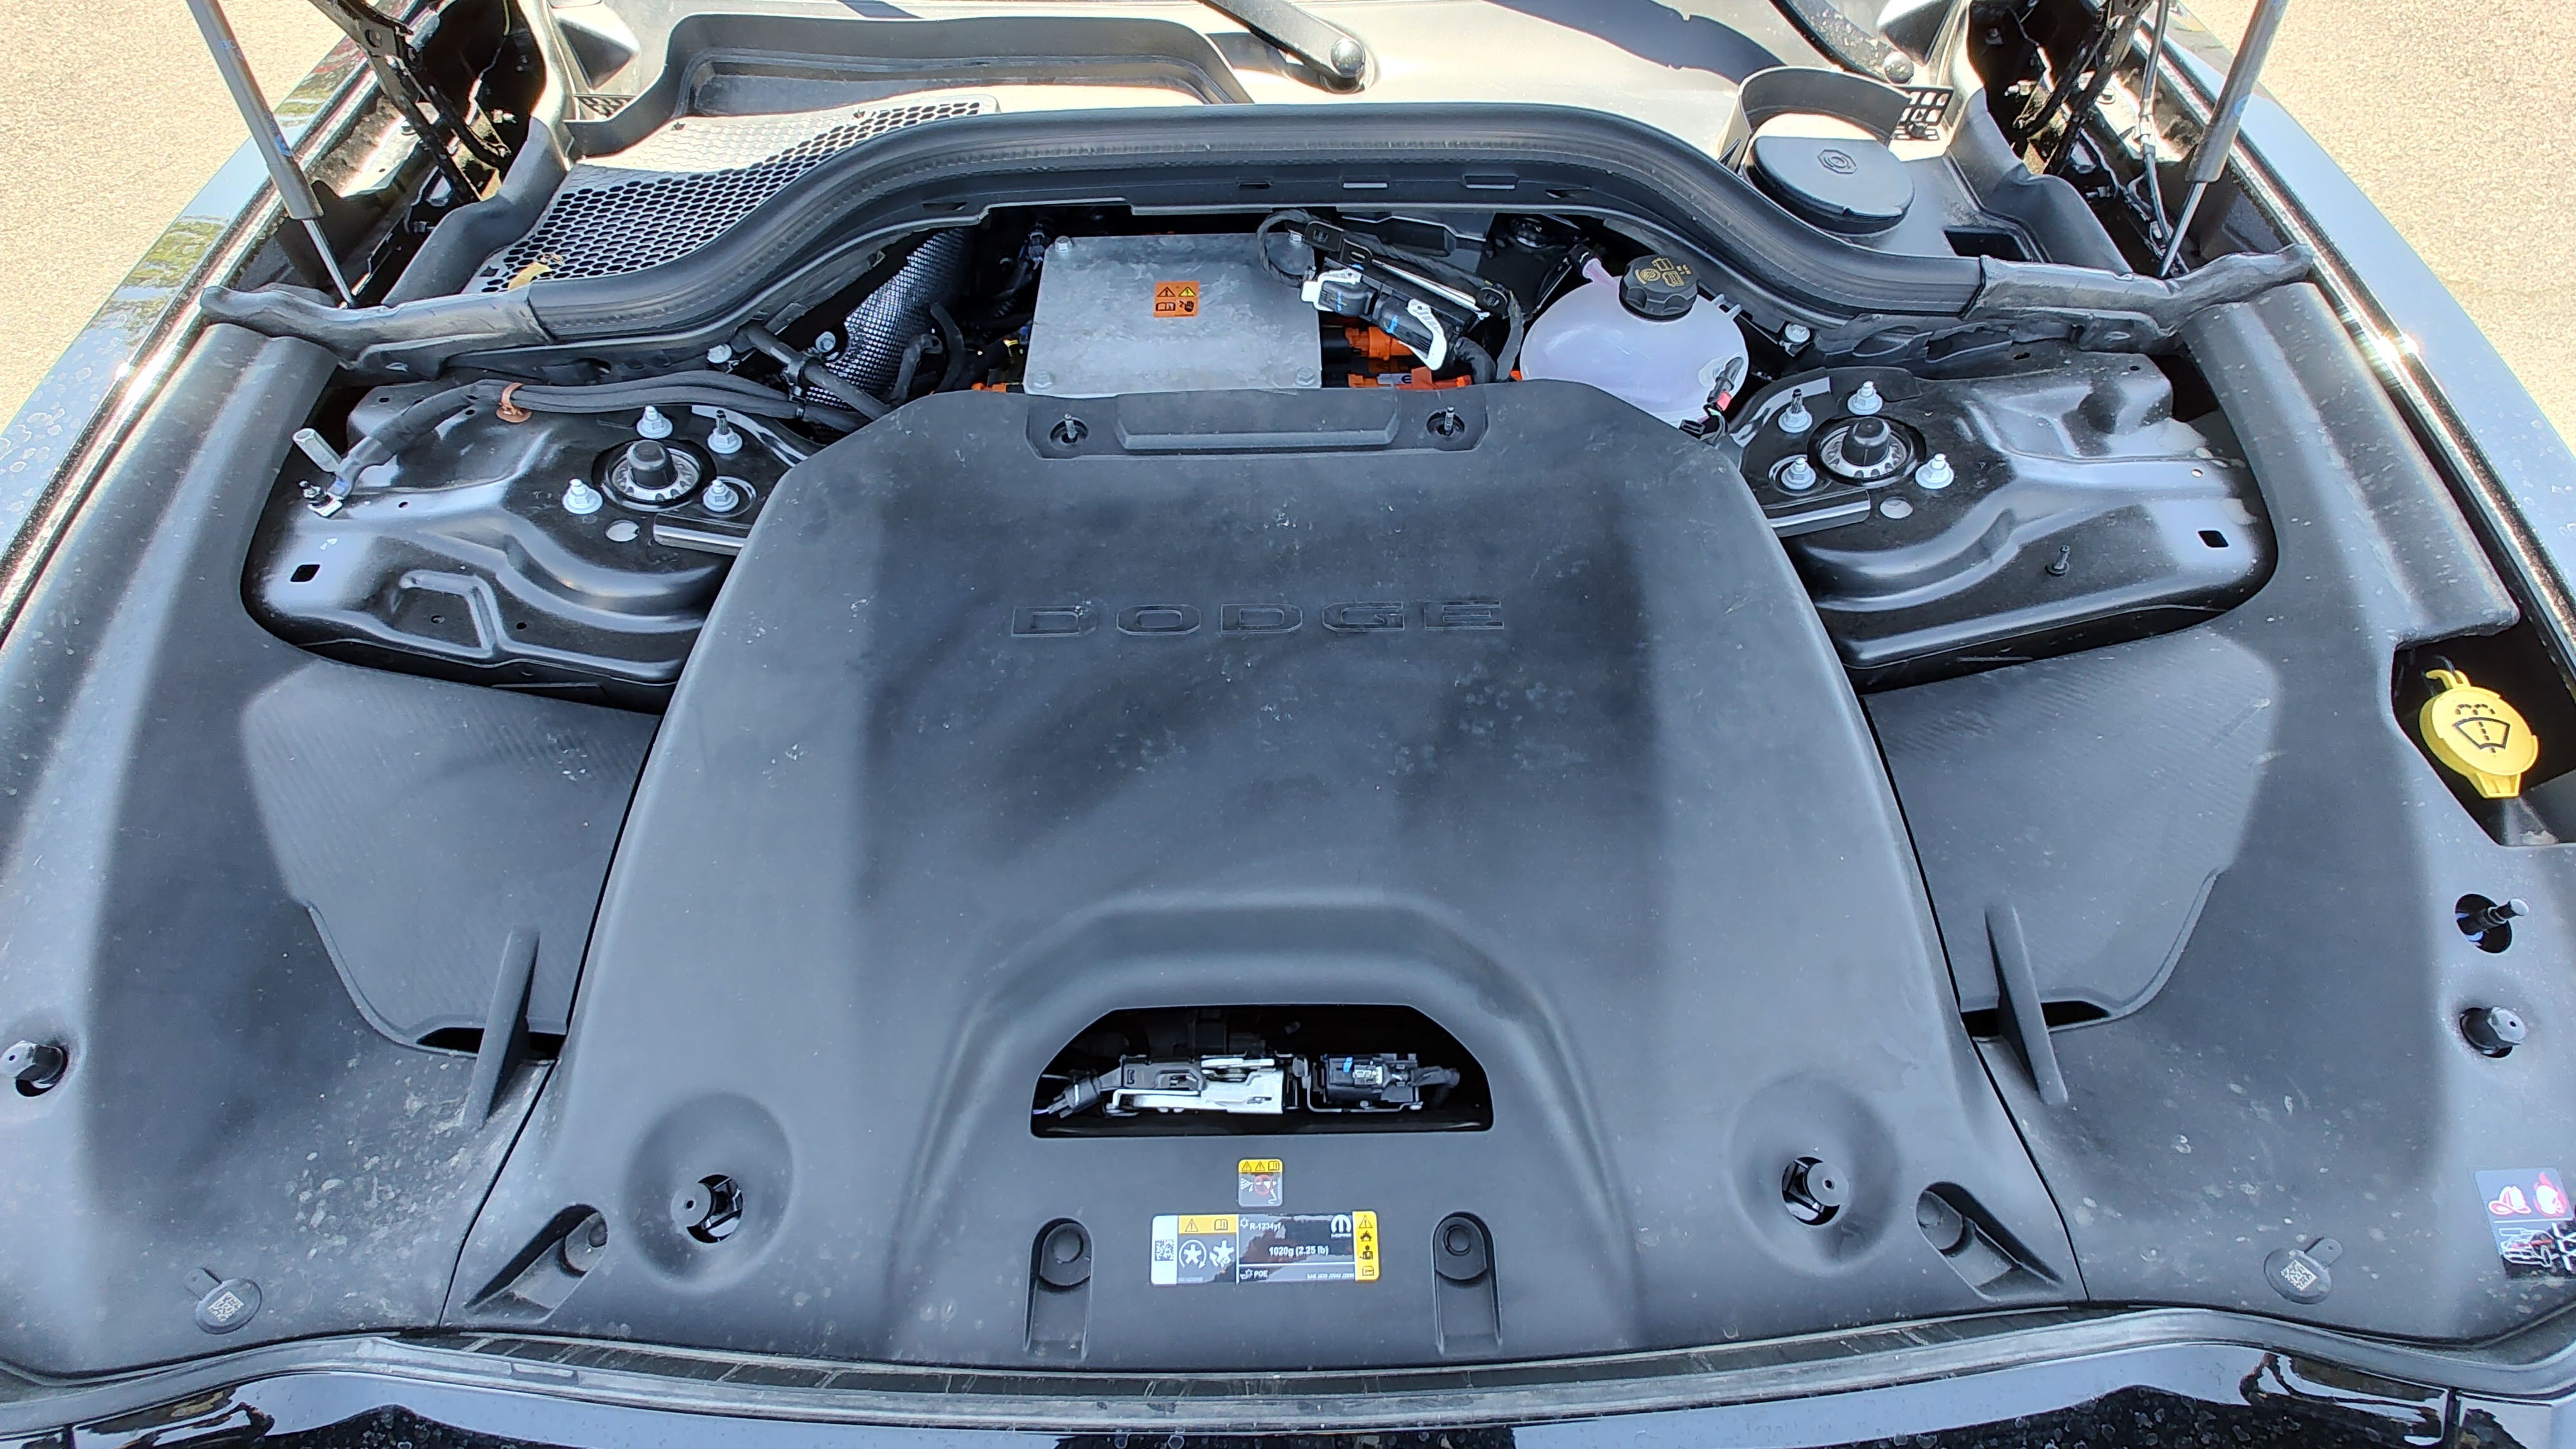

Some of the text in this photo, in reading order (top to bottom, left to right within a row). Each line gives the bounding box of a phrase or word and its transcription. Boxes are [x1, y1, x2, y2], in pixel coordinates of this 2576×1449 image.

[1011, 599, 1505, 637] DODGE
[1269, 1245, 1329, 1257] 1020g (2.25 lb)
